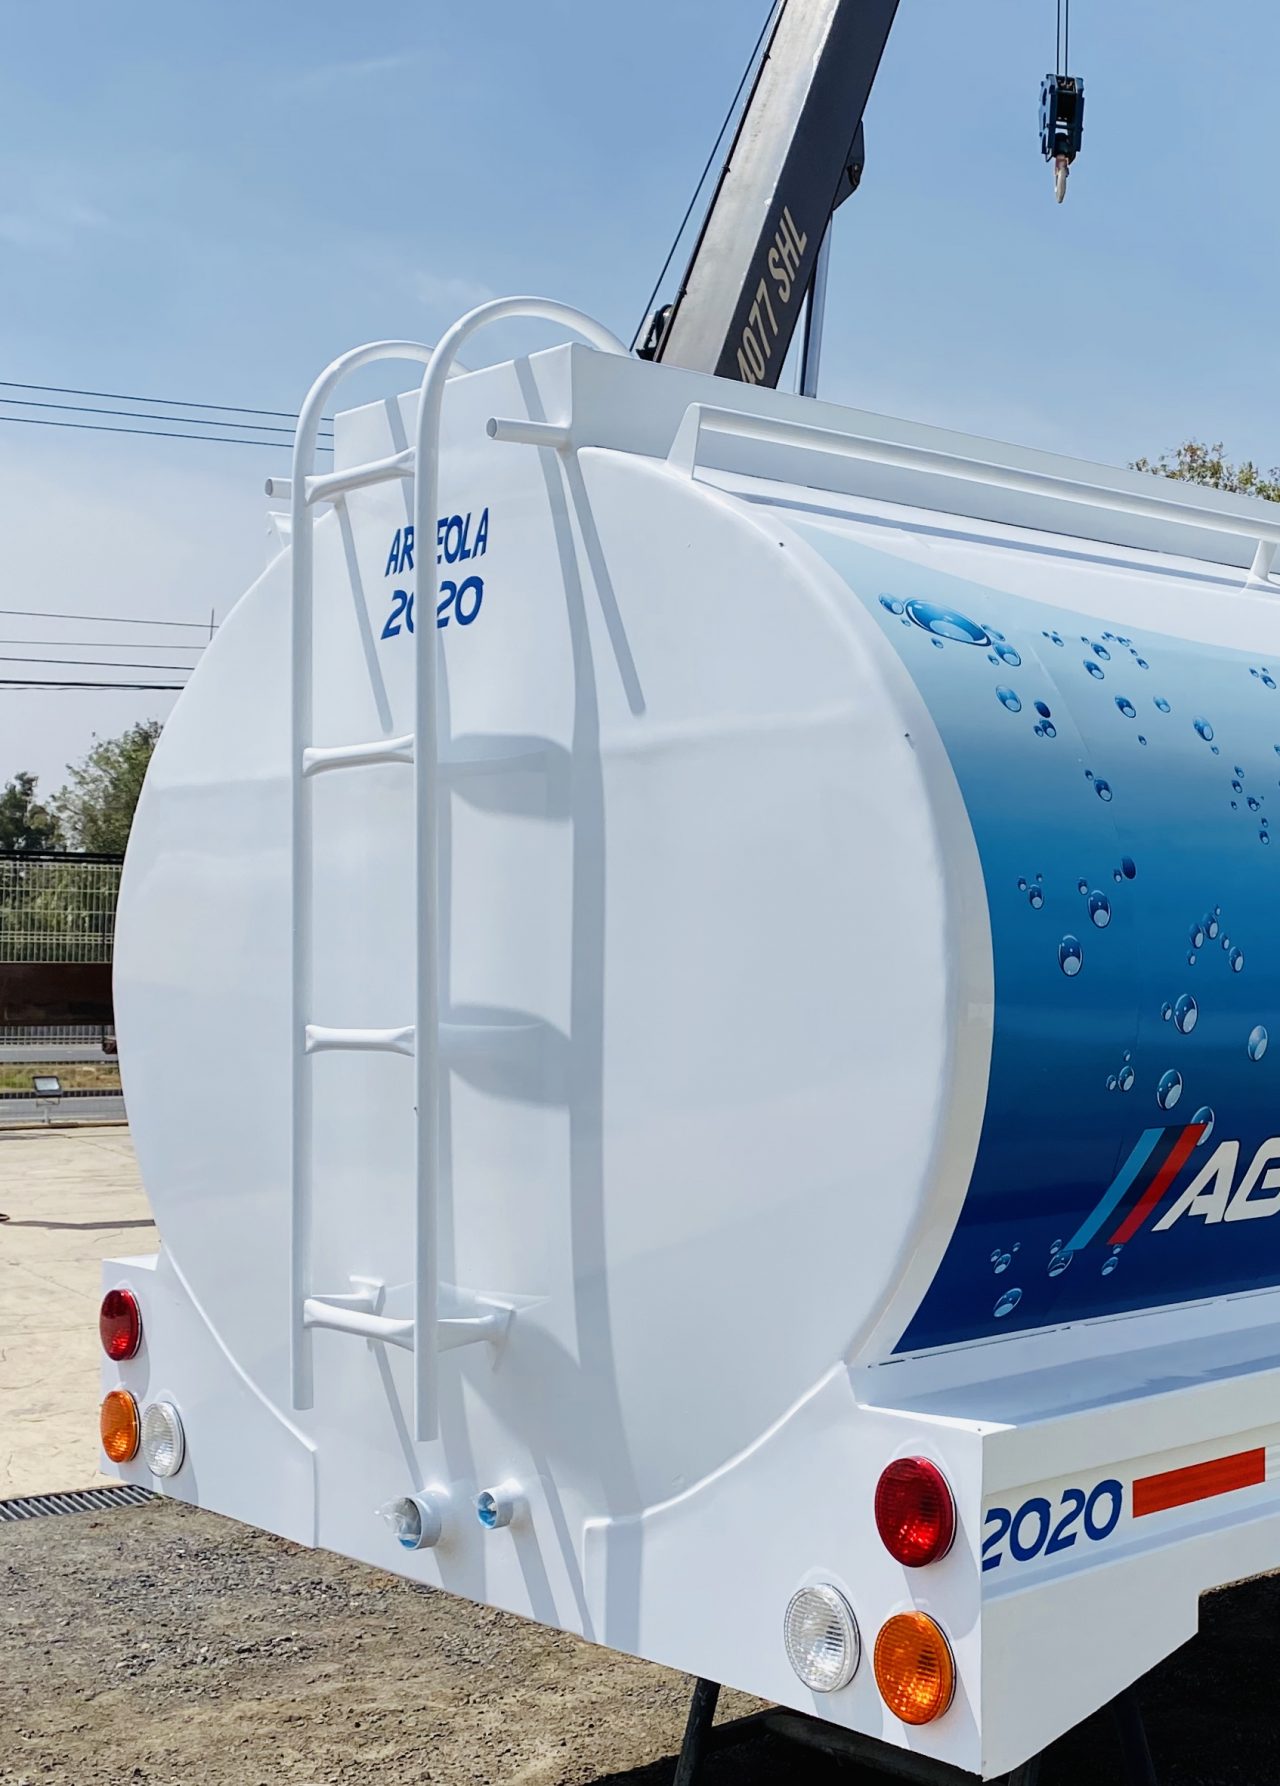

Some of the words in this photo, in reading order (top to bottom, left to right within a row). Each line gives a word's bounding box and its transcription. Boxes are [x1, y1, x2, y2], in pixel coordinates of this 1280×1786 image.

[768, 206, 808, 303] SHL
[384, 507, 489, 578] AREOLA
[982, 1479, 1124, 1572] 2020
